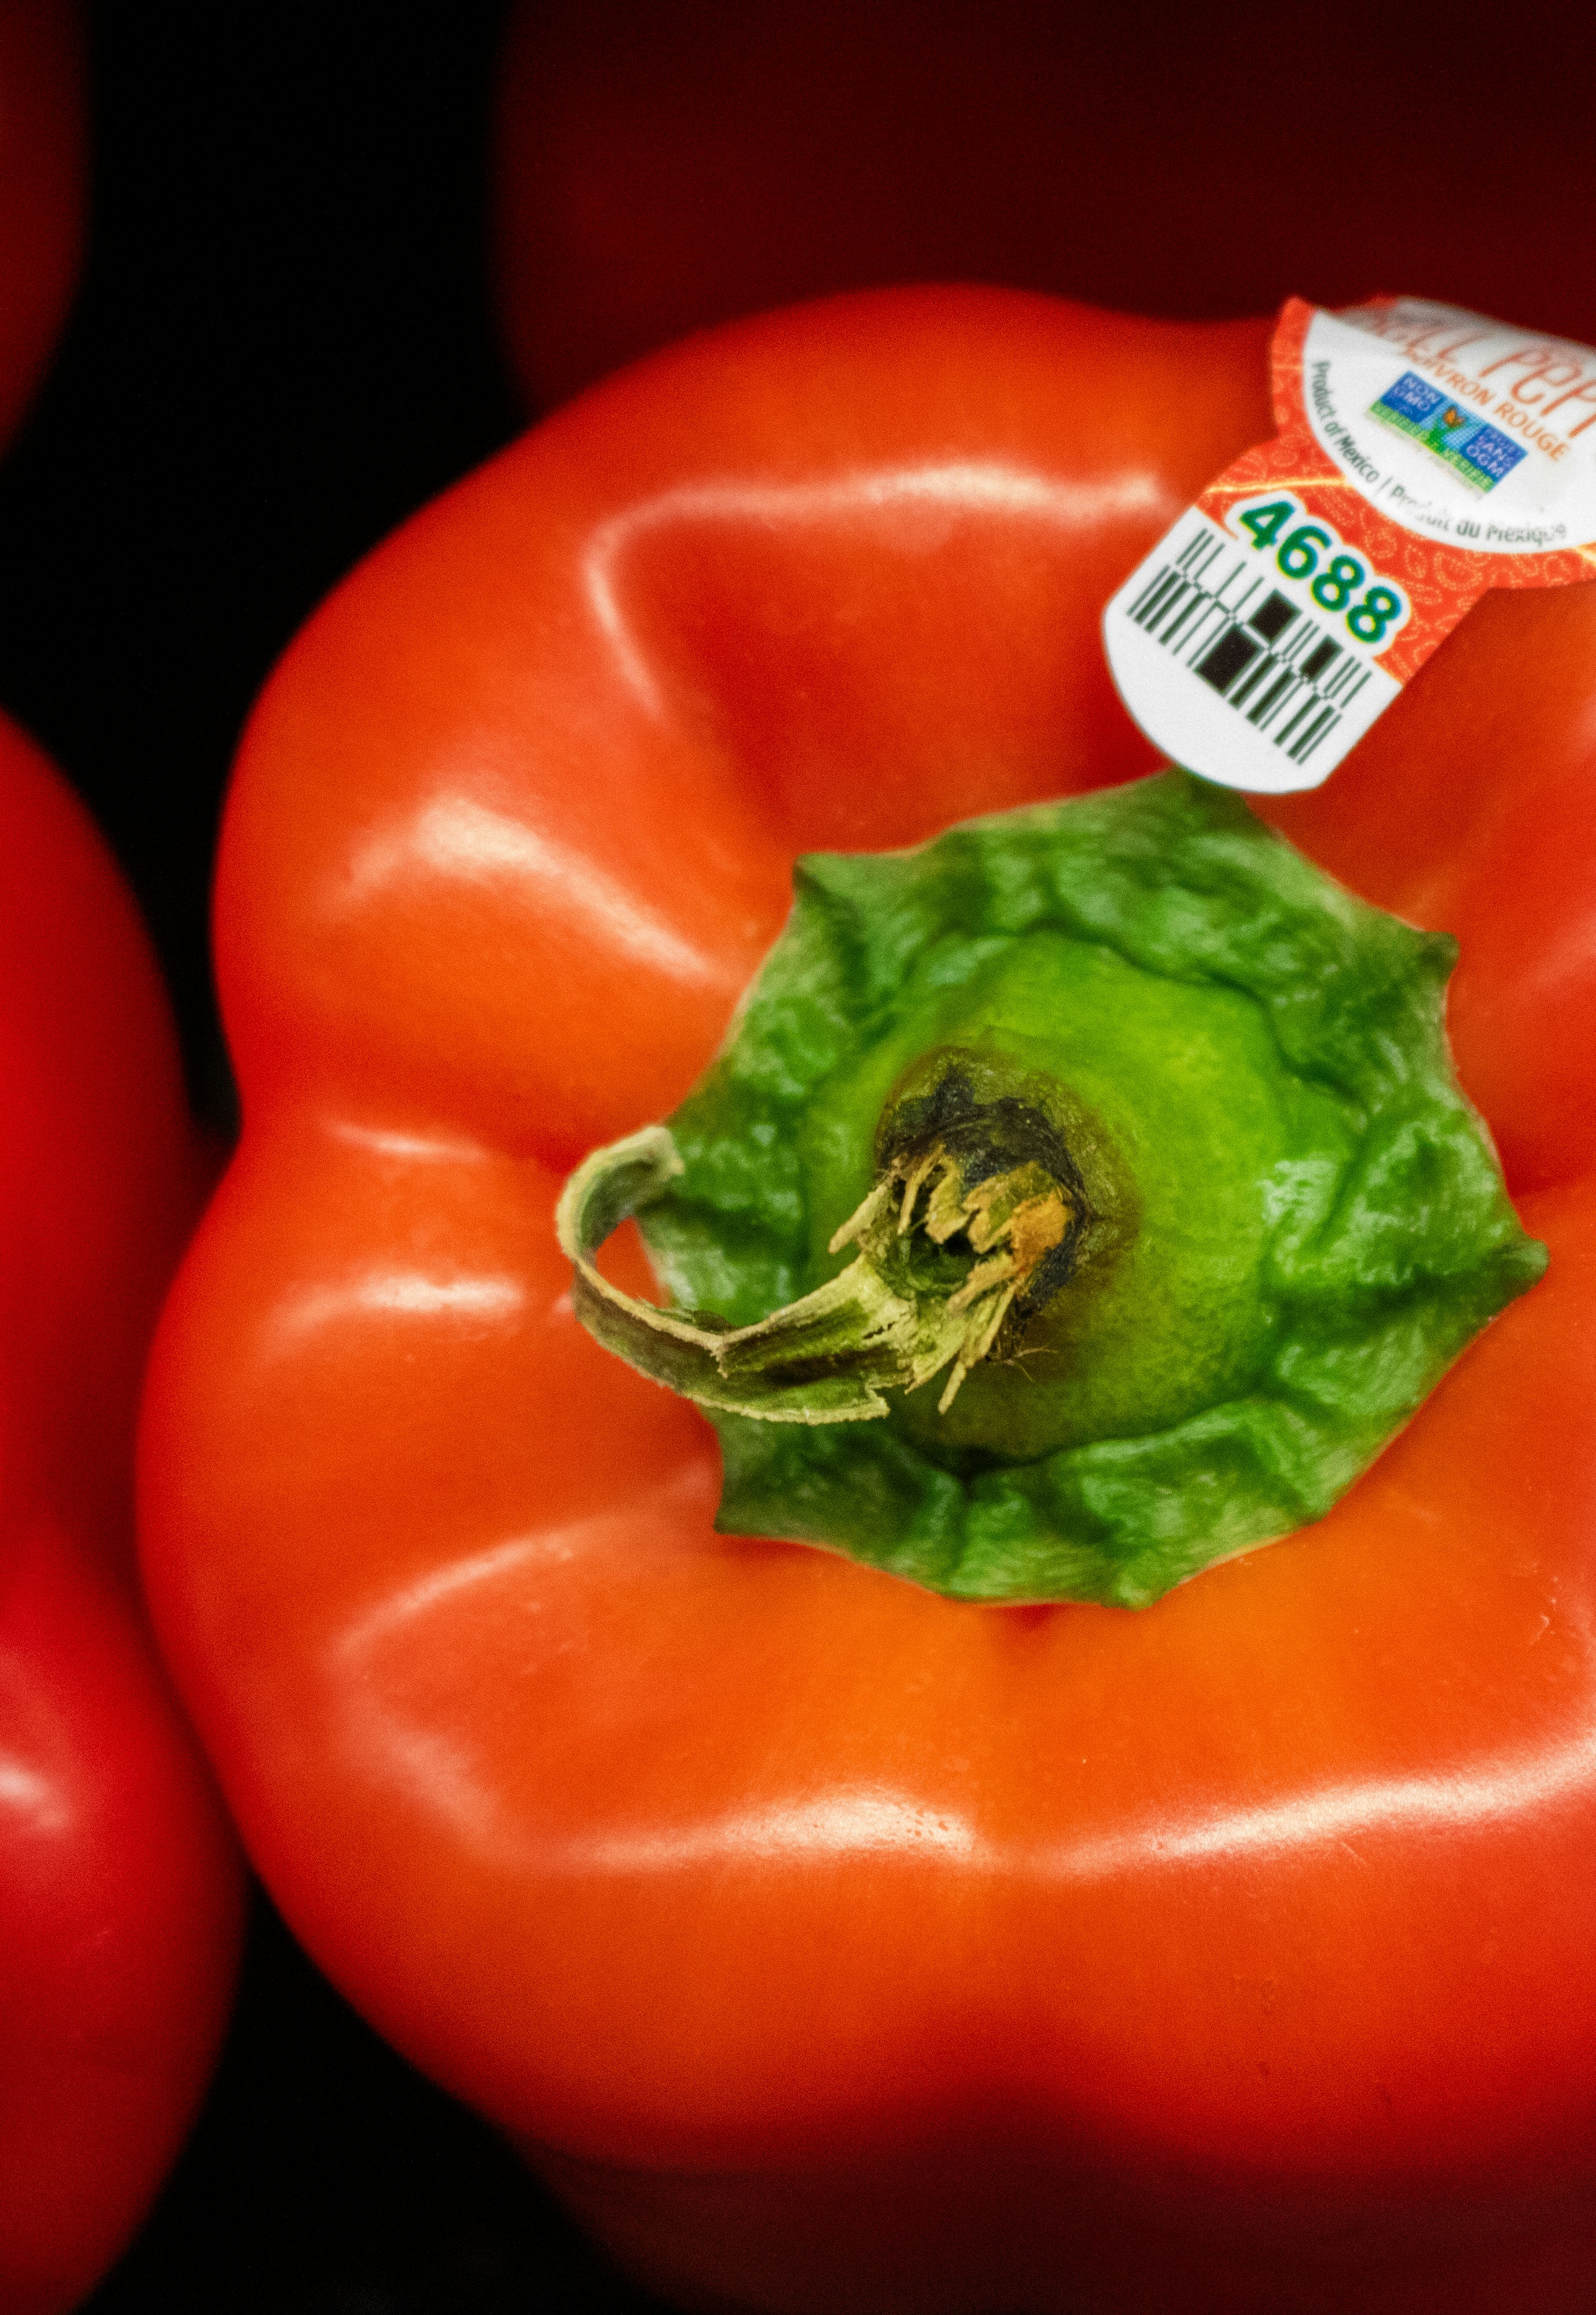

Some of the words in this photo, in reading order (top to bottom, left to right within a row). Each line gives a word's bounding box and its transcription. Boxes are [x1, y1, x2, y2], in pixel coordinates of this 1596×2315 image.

[1323, 420, 1348, 438] of
[1494, 400, 1572, 461] ROUGE
[1333, 435, 1380, 484] Mexico
[1465, 443, 1507, 478] OGM
[1456, 518, 1482, 539] du
[1240, 501, 1403, 644] 4688
